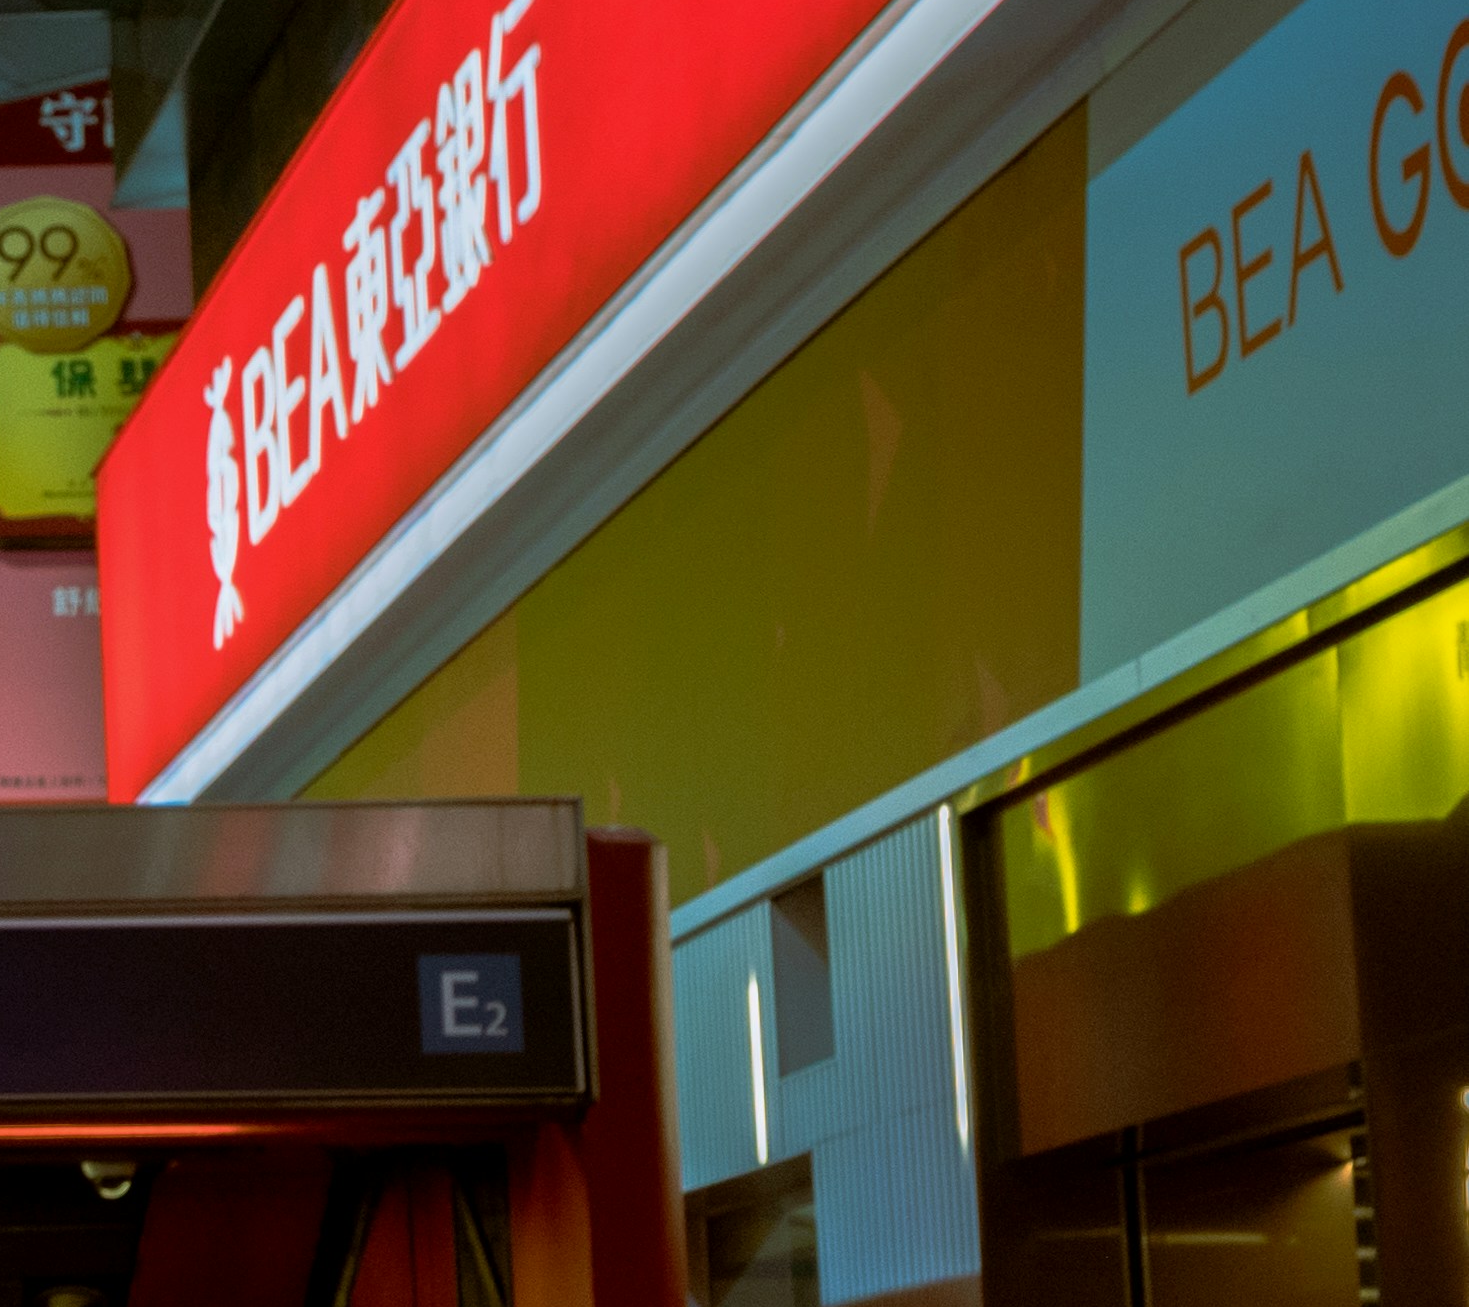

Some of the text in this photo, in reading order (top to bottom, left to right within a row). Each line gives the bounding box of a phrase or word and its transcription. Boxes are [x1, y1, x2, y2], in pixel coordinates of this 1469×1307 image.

[38, 90, 115, 152] 守
[1179, 149, 1344, 397] BEA
[242, 263, 348, 546] BEA
[441, 969, 509, 1037] E2
